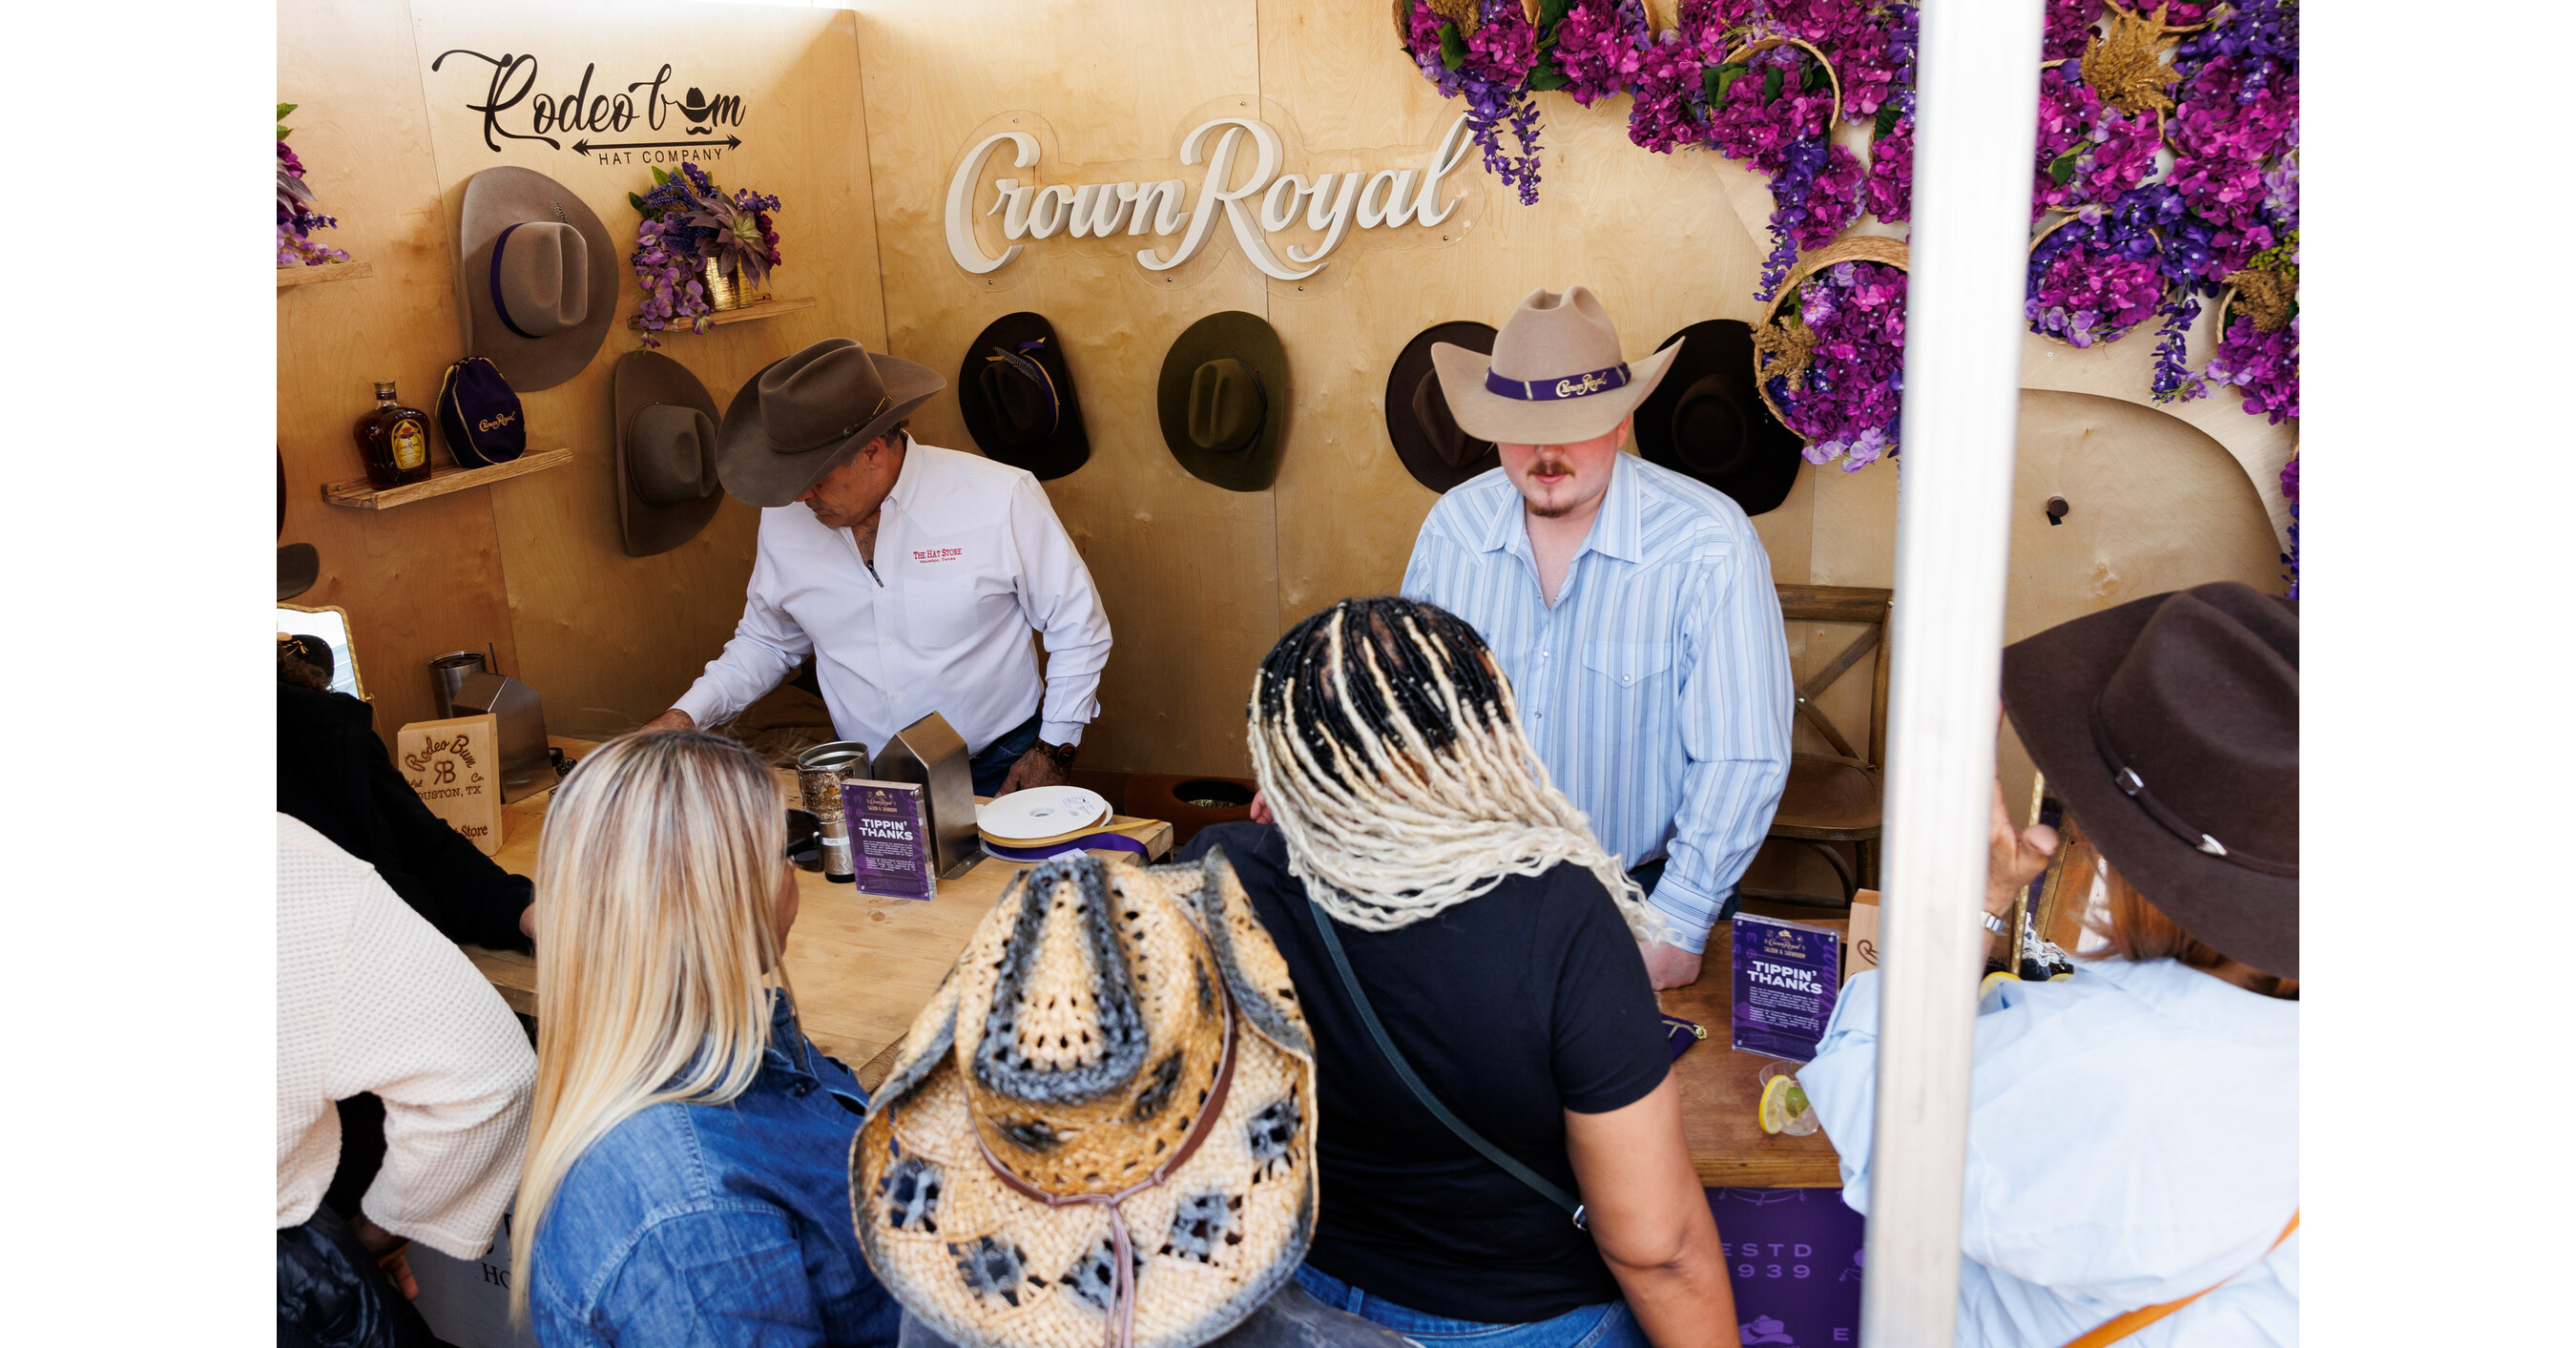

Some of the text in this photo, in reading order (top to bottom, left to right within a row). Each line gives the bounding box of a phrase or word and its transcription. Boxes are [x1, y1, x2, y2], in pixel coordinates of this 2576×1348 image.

[432, 50, 640, 153] Rodeo
[598, 148, 722, 165] HAT COMPANY
[945, 114, 1477, 280] Crown Royal
[1555, 371, 1607, 398] Crown Royal
[479, 411, 515, 431] Crown Royal
[405, 735, 476, 773] Rodeo Bum
[418, 786, 482, 800] OUSTON, TX
[461, 825, 488, 838] Store
[859, 827, 913, 840] THANKS
[862, 819, 907, 831] TIPPIN'
[1752, 960, 1817, 982] TIPPIN'
[1747, 970, 1823, 995] THANKS
[1721, 1242, 1813, 1257] ESTD
[1737, 1263, 1811, 1279] 939
